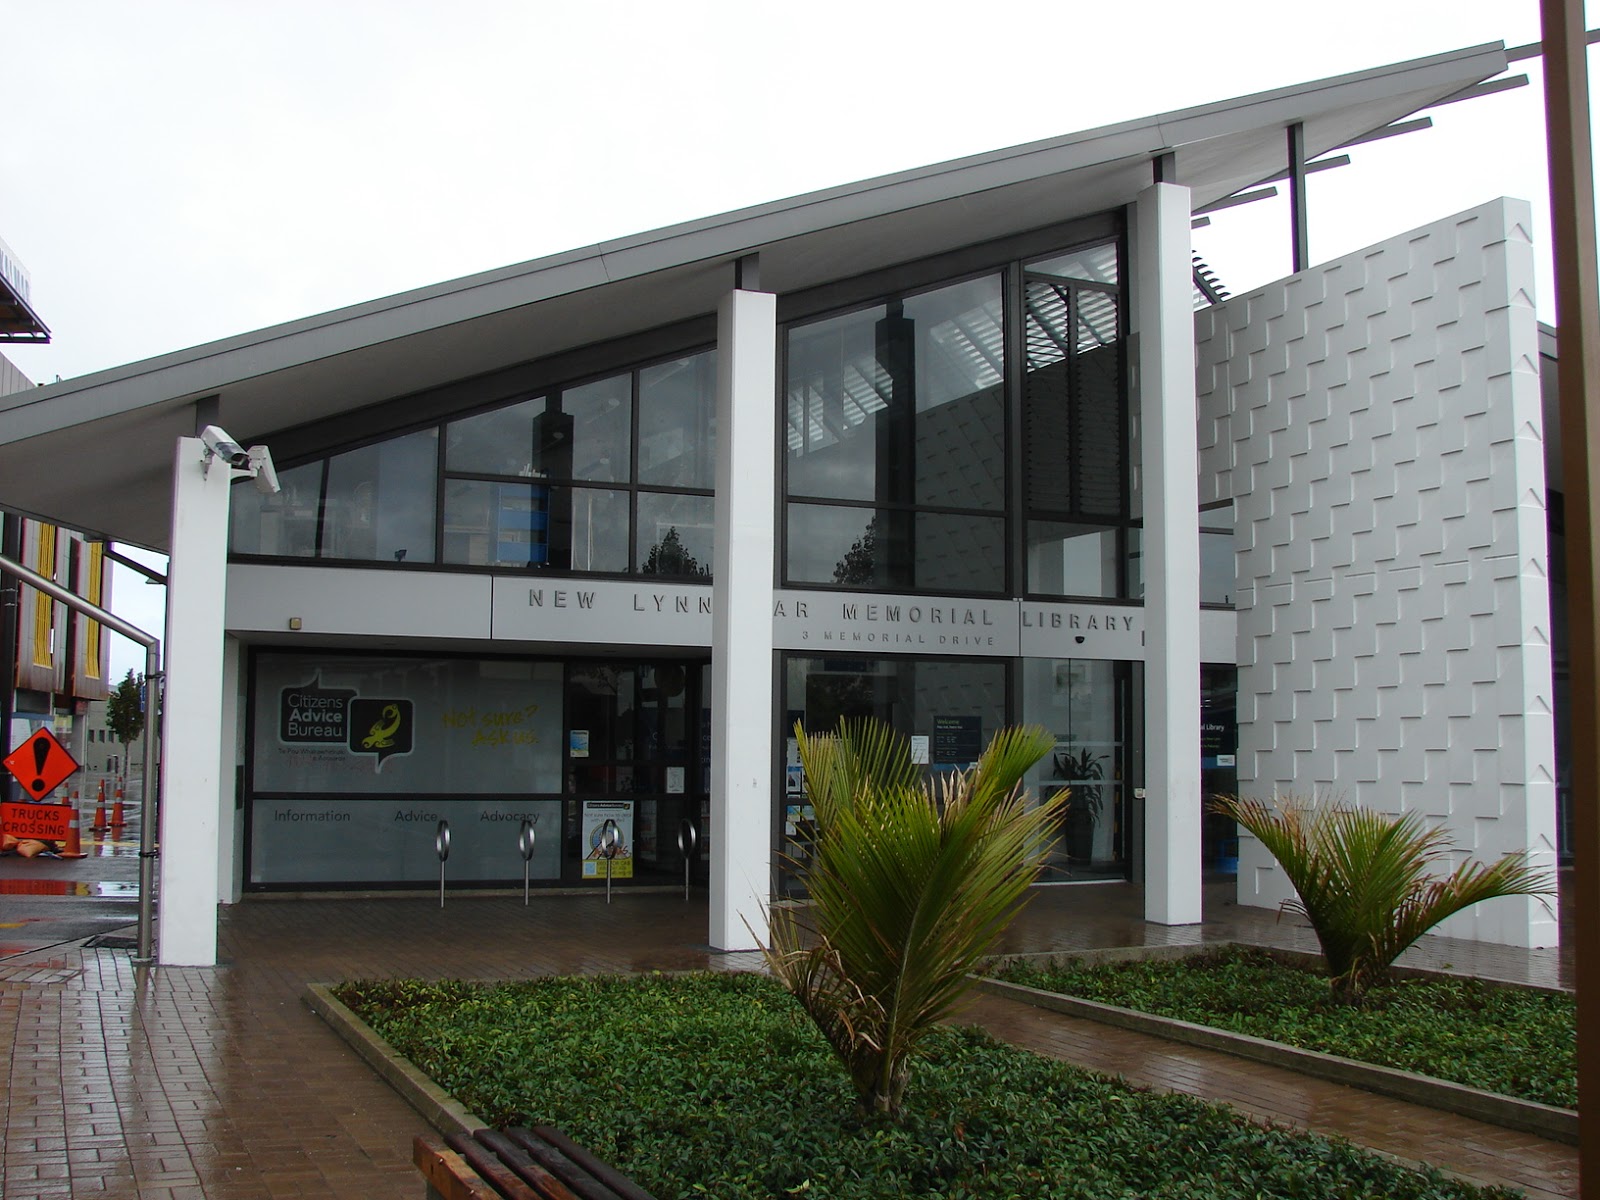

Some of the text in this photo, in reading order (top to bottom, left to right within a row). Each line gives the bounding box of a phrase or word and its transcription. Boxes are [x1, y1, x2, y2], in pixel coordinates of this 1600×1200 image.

[529, 589, 1135, 632] NEW LYNN AR MEMORIAL LIBRARY
[802, 630, 994, 647] 3 MEMORIAL DRIVE
[288, 694, 343, 708] Citizens
[289, 708, 343, 722] Advice
[288, 722, 343, 737] Bureau
[1206, 723, 1225, 732] Library
[11, 807, 60, 820] TRUCKS
[274, 810, 540, 824] Information Advice Advocacy
[2, 821, 65, 836] CROSSING
